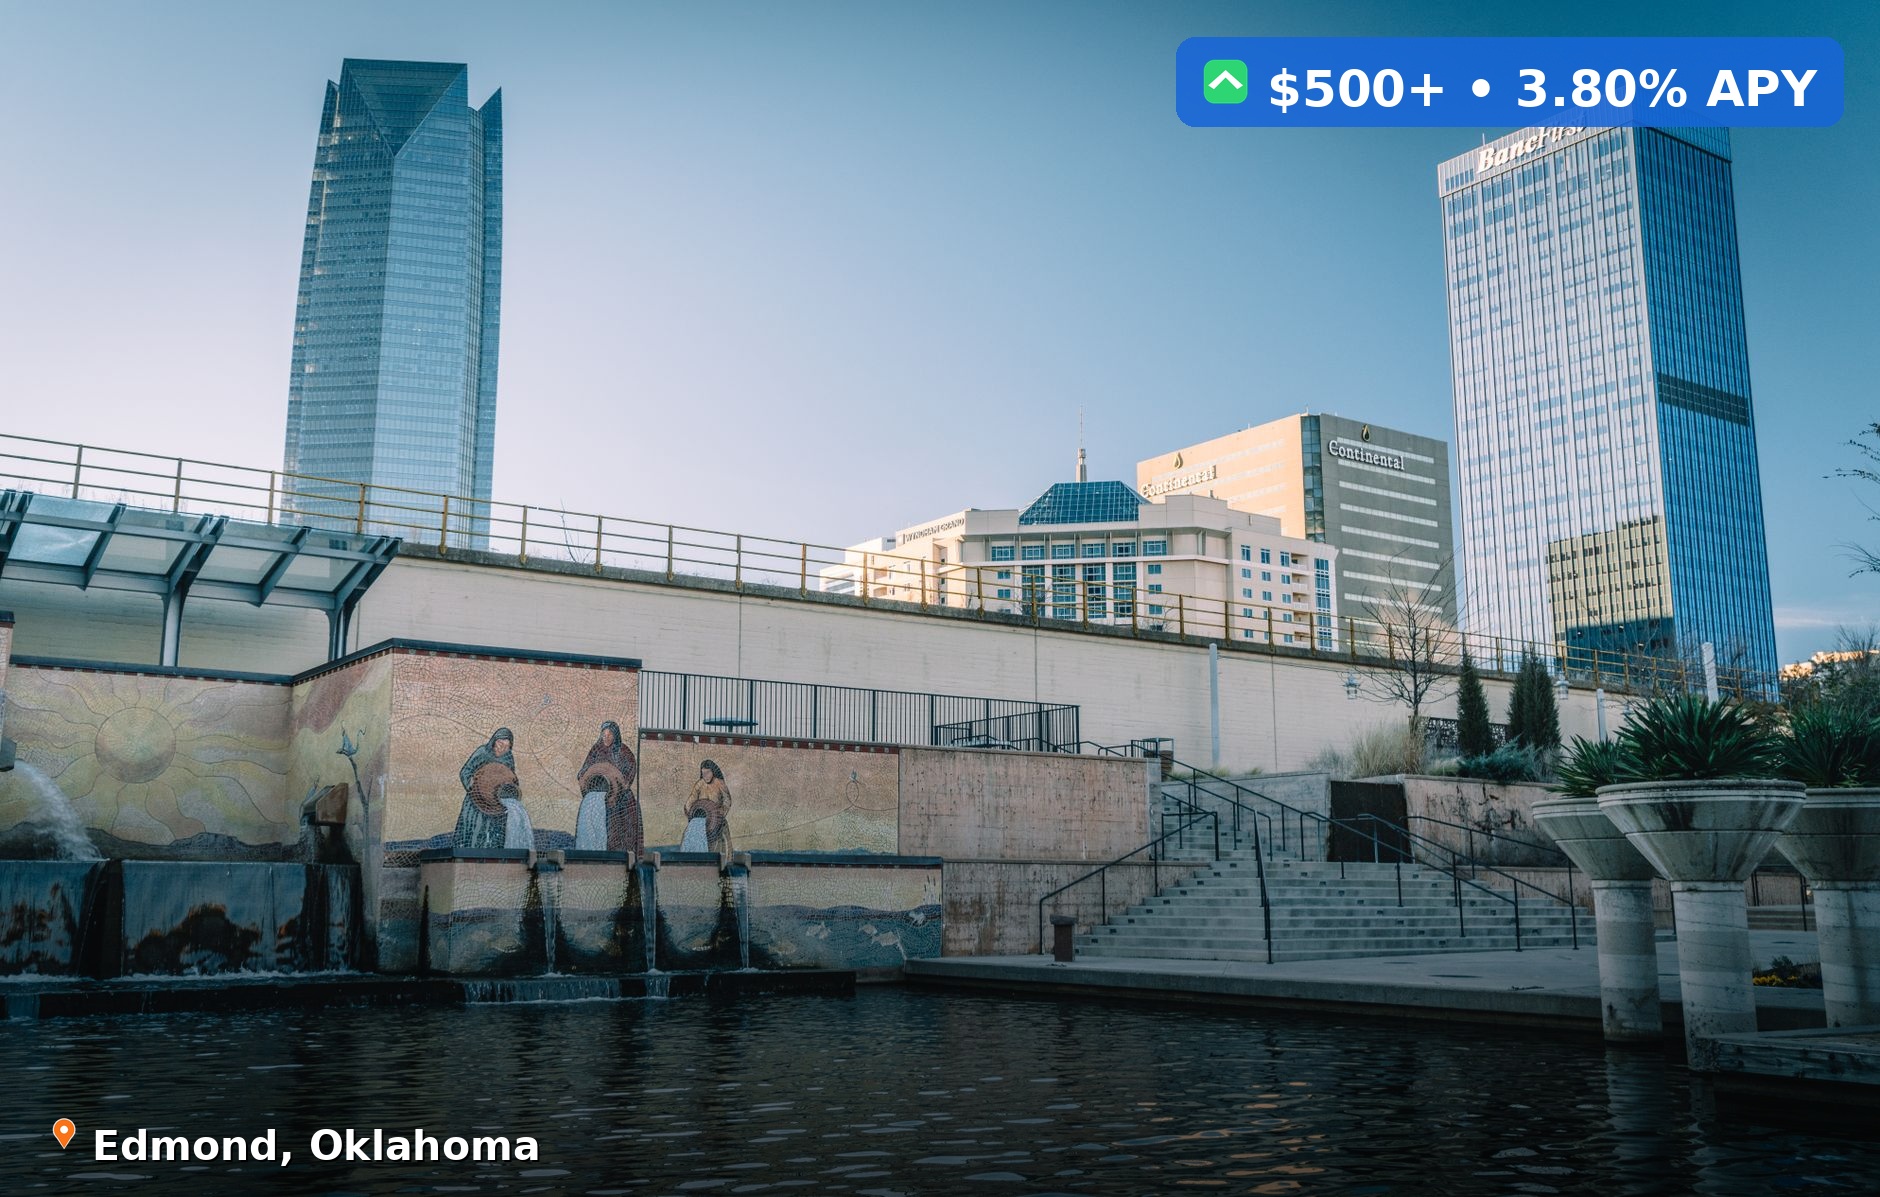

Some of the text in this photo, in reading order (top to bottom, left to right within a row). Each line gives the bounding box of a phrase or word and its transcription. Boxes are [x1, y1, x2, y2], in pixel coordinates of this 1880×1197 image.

[1476, 126, 1588, 173] BancFirs
[1328, 439, 1405, 471] Continental
[1141, 465, 1217, 498] Continental
